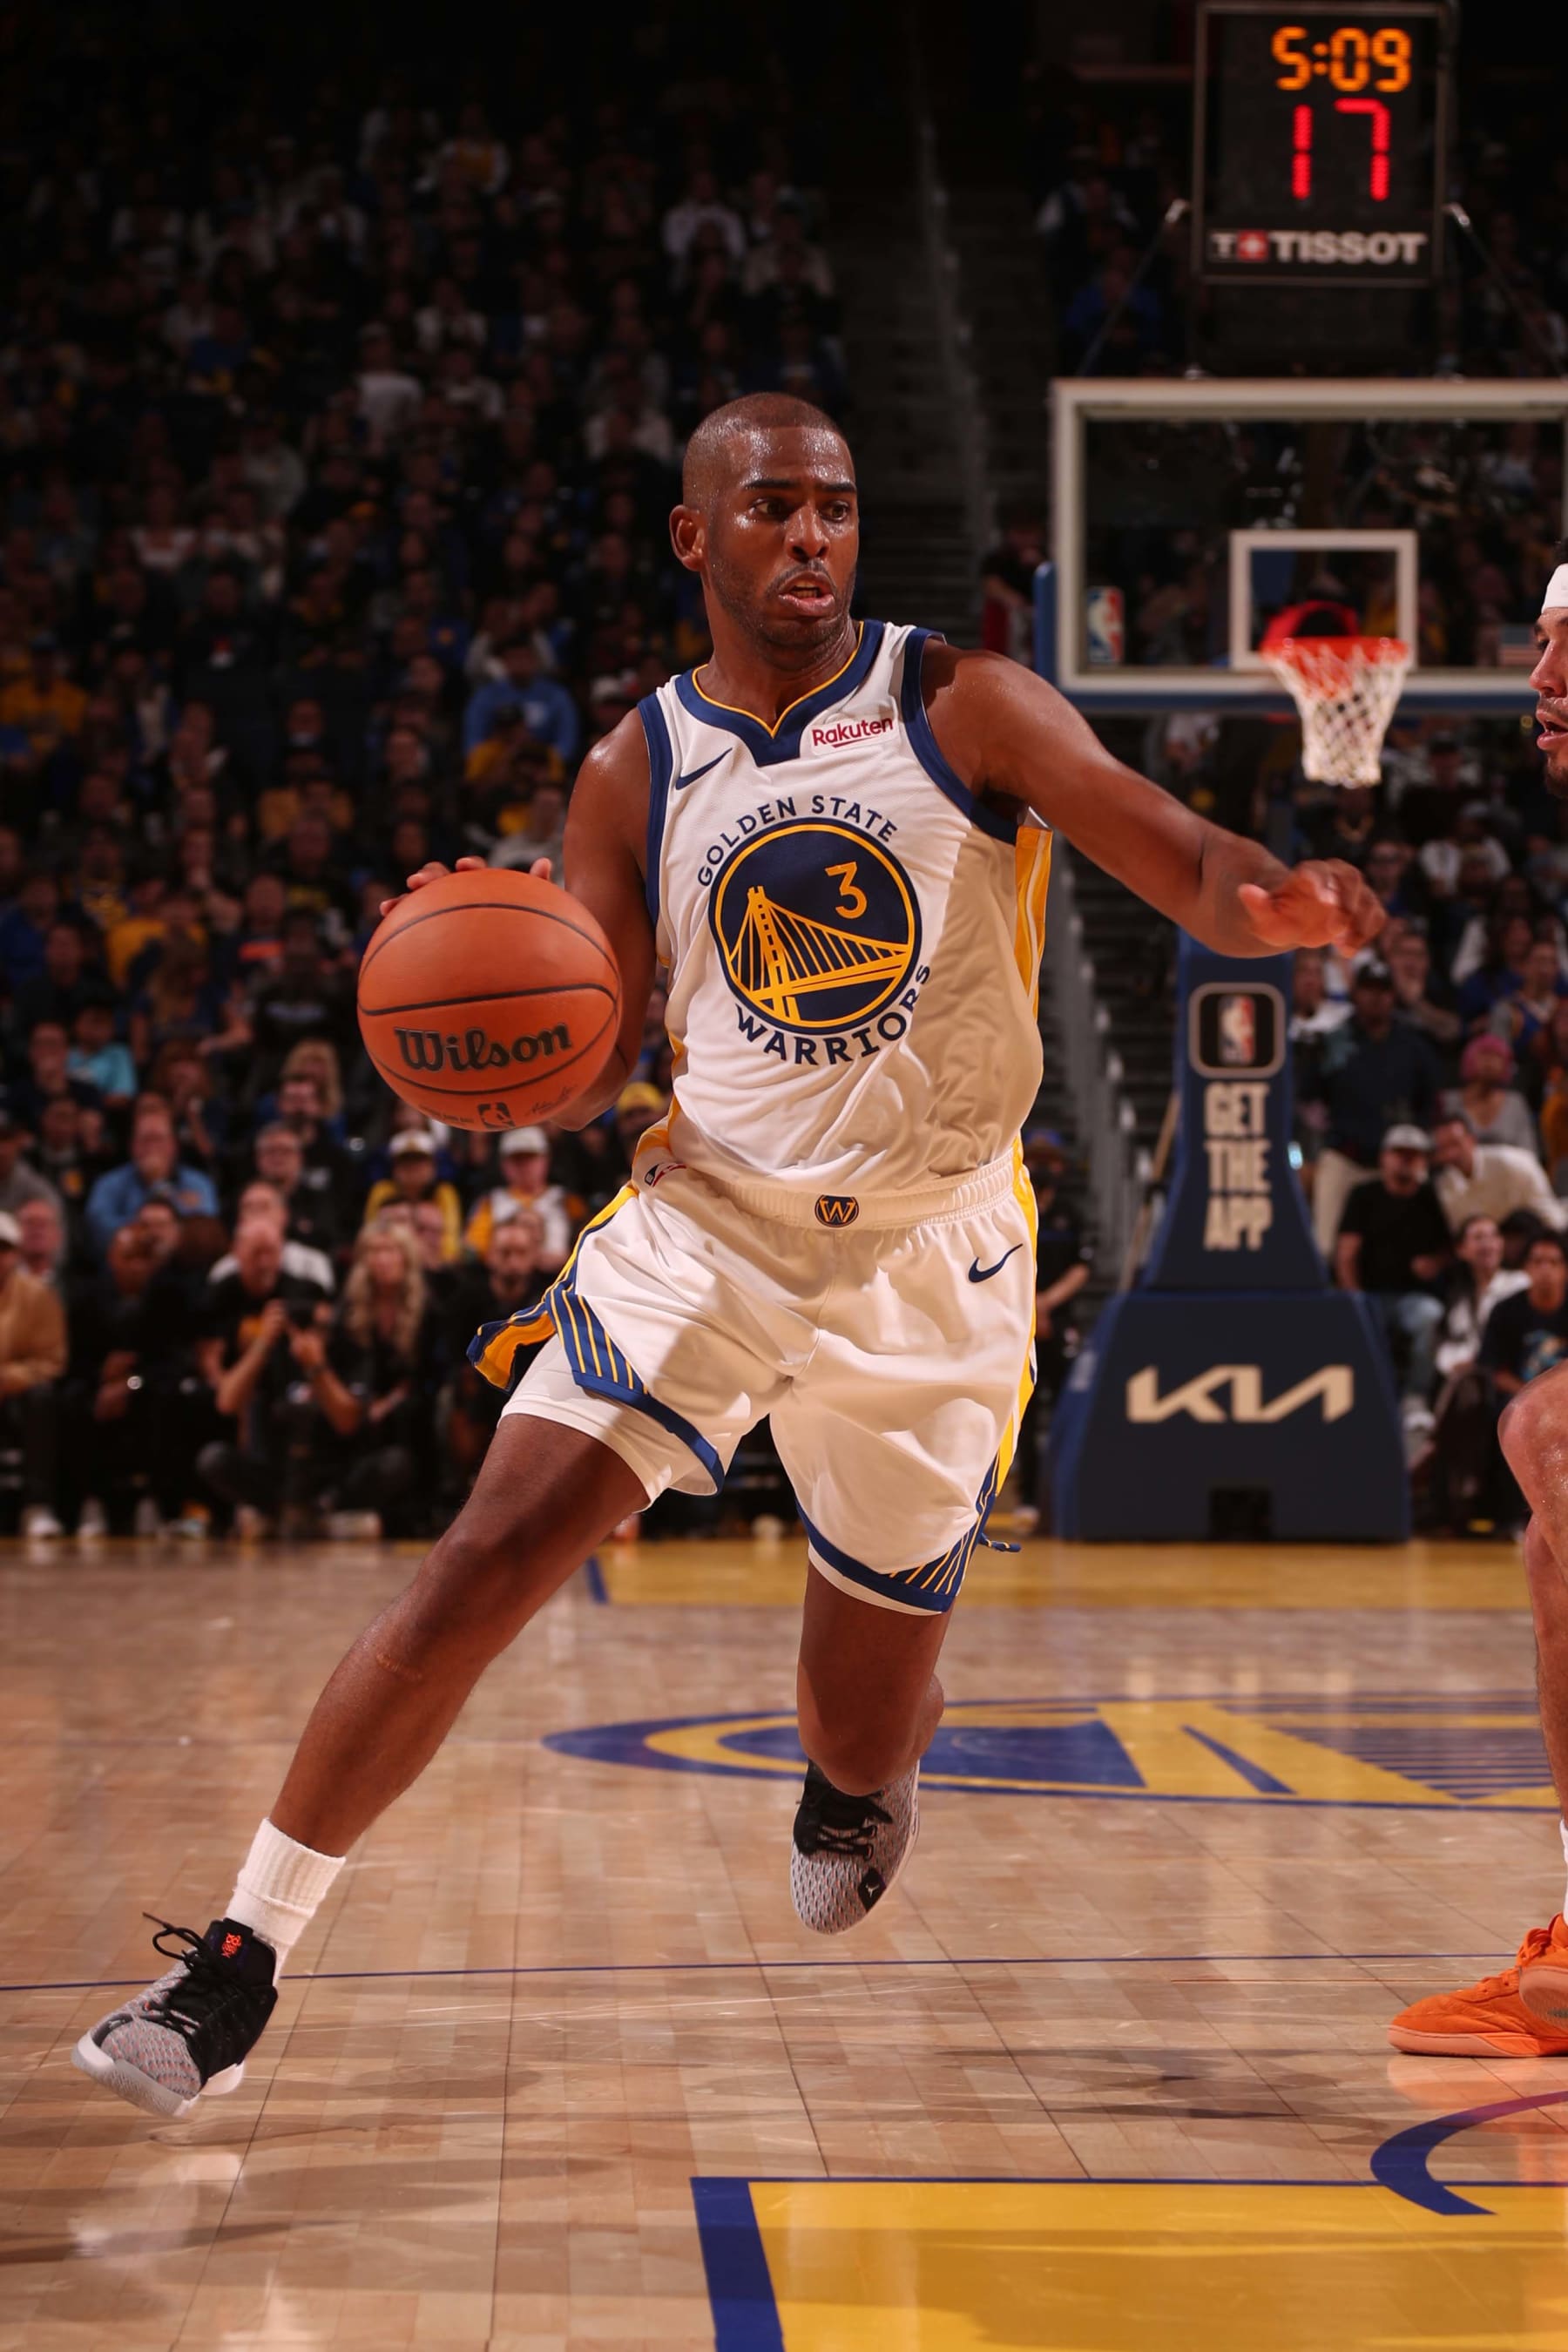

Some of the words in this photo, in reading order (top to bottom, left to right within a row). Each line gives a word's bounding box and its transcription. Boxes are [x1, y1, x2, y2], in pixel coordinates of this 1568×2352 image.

[1271, 25, 1412, 93] 5:09
[1291, 97, 1391, 202] 17
[1268, 231, 1427, 264] TISSOT
[812, 717, 894, 748] Rakuten
[698, 794, 796, 887] GOLDEN
[811, 794, 897, 843] STATE
[824, 861, 868, 920] 3
[734, 963, 930, 1066] WARRIORS
[394, 1022, 571, 1072] Wilson
[1205, 1081, 1269, 1137] GET
[1204, 1139, 1272, 1193] THE
[1203, 1193, 1273, 1251] APP
